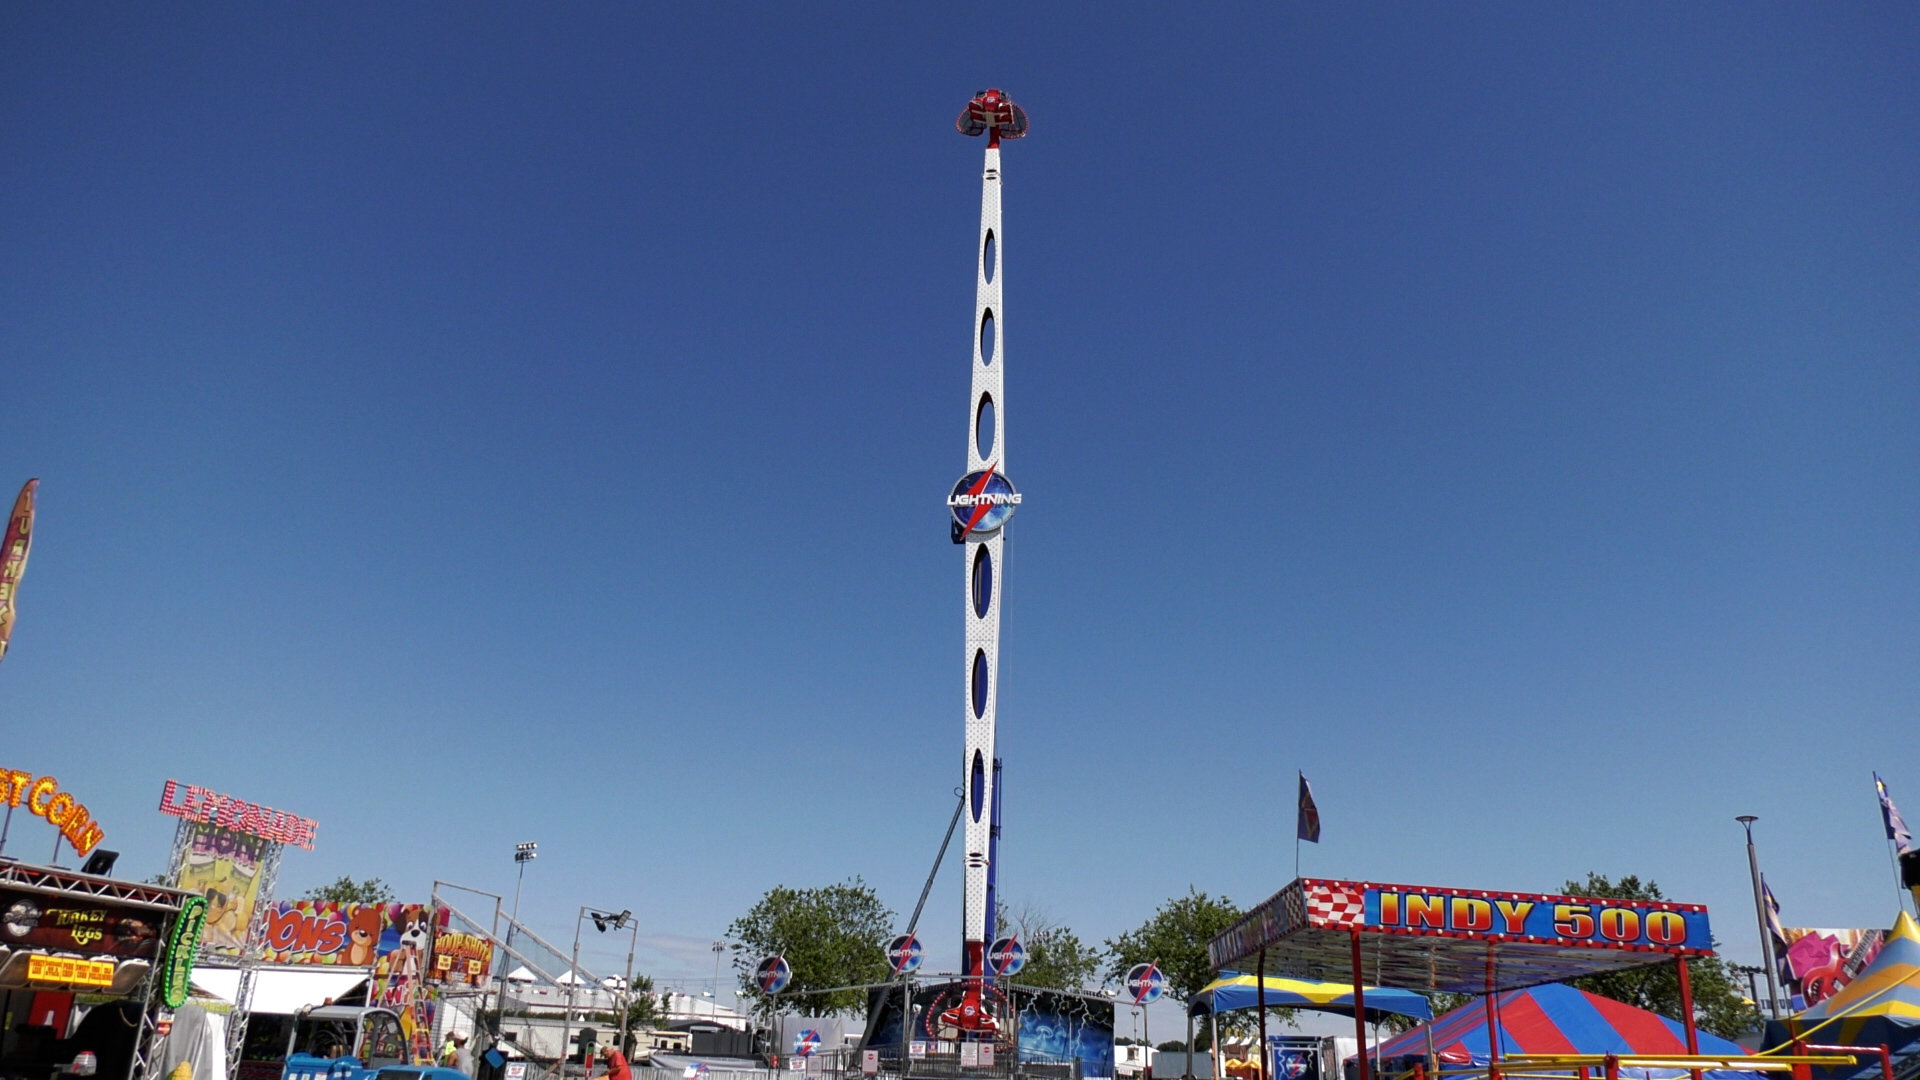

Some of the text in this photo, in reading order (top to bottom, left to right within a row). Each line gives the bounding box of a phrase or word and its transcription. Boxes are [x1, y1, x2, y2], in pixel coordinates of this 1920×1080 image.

[946, 493, 1022, 506] LIGHTNING
[28, 776, 105, 858] CORN
[160, 779, 319, 851] LEMONADE
[46, 909, 107, 925] TURKEY
[1378, 891, 1687, 946] INDY 500
[71, 924, 103, 945] LEGS
[434, 933, 488, 960] HOOP SHOT
[169, 905, 203, 1003] PICKLES
[987, 952, 1030, 961] LIGHTNING
[1123, 978, 1168, 987] LIGHTNING
